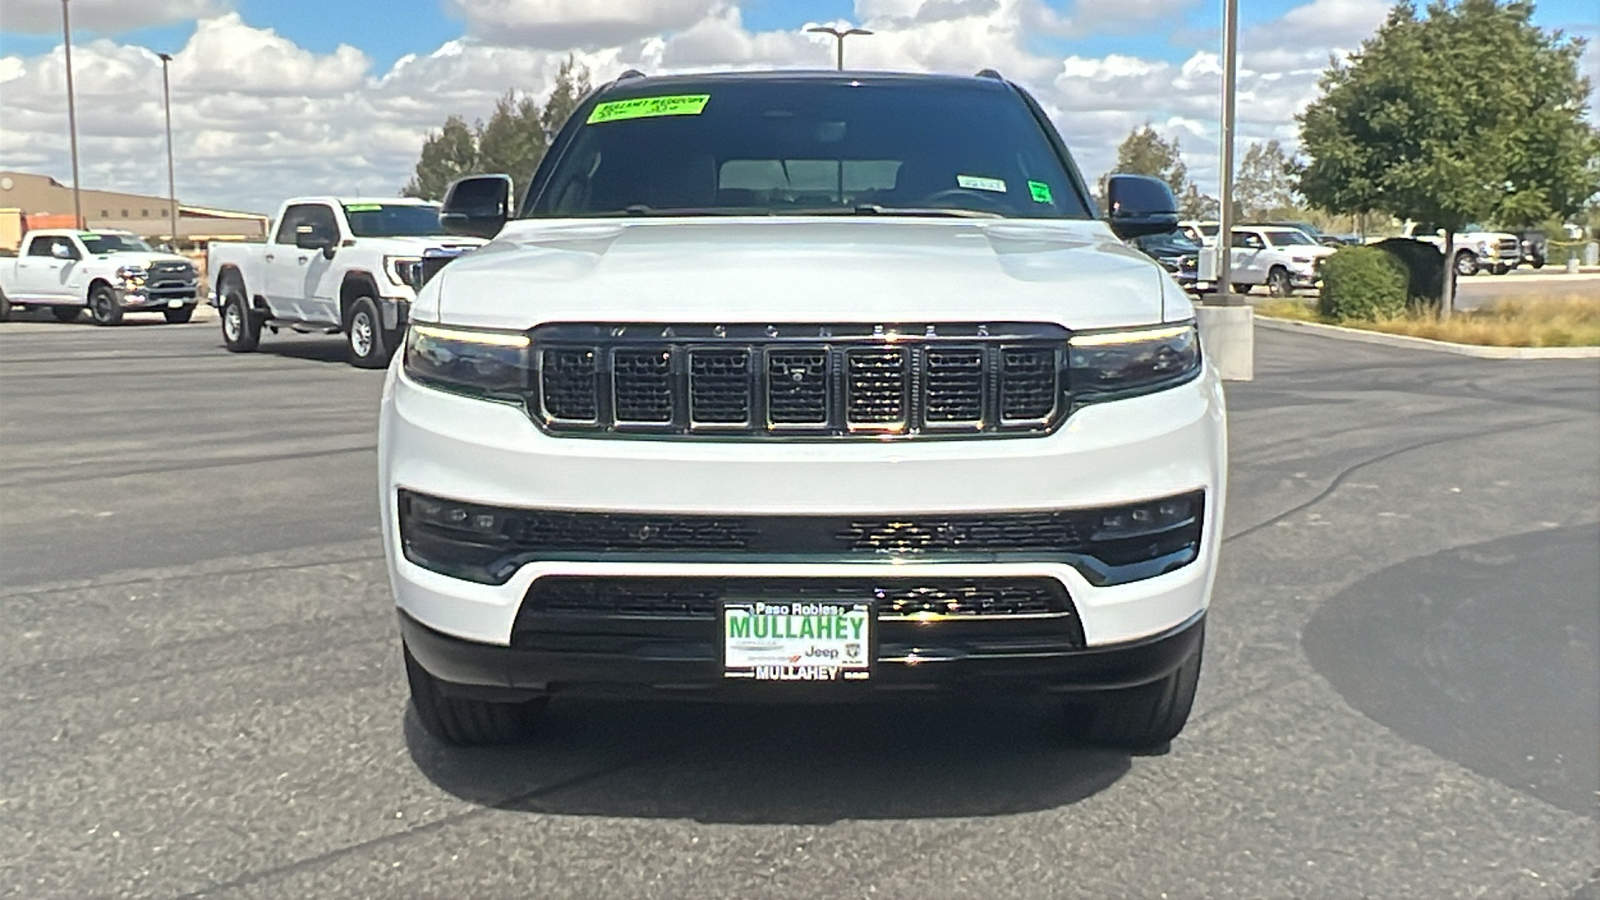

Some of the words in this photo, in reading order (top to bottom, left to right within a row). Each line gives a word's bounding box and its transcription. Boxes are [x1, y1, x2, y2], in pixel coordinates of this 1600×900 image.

[756, 602, 790, 615] Paso
[792, 602, 837, 616] Robles
[729, 615, 865, 640] MULLAHEY
[805, 645, 839, 660] Jeep
[755, 665, 838, 681] MULLAHEY
